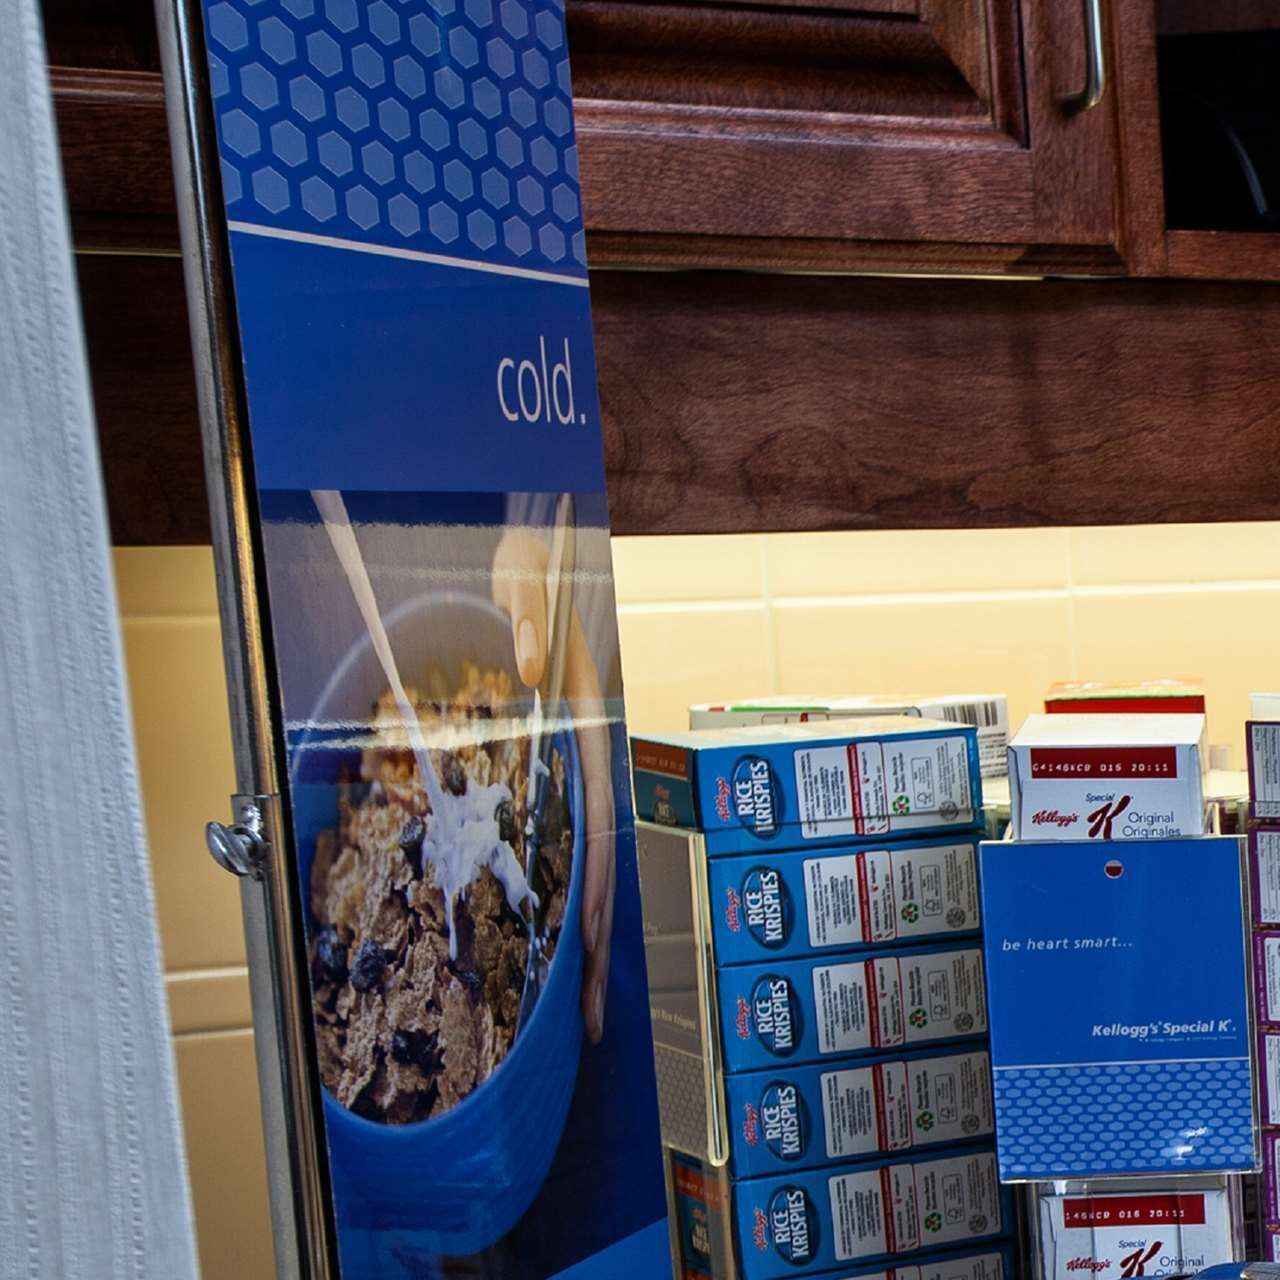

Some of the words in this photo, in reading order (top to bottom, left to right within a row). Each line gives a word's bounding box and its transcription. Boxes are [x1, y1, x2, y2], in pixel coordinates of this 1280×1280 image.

[496, 335, 587, 425] cold.
[736, 780, 754, 816] RICE
[750, 760, 775, 832] KRISPIES
[1085, 792, 1116, 803] Special
[1032, 810, 1080, 827] Kellogg's
[1087, 795, 1132, 840] K
[1122, 825, 1181, 839] Originales
[1128, 811, 1174, 826] Original
[746, 891, 764, 925] RICE
[760, 871, 783, 940] KRISPIES
[1002, 938, 1021, 951] be
[1027, 936, 1068, 950] heart
[1074, 936, 1133, 949] smart...
[756, 1000, 774, 1033] RICE
[770, 980, 792, 1048] KRISPIES
[1162, 1020, 1214, 1036] Special
[764, 1105, 781, 1140] RICE
[778, 1086, 800, 1153] KRISPIES
[773, 1209, 791, 1243] RICE
[787, 1190, 808, 1257] KRISPIES
[1066, 1257, 1112, 1272] Kellogg's
[1120, 1241, 1162, 1278] K
[1119, 1240, 1147, 1249] Special
[1160, 1255, 1205, 1269] Original
